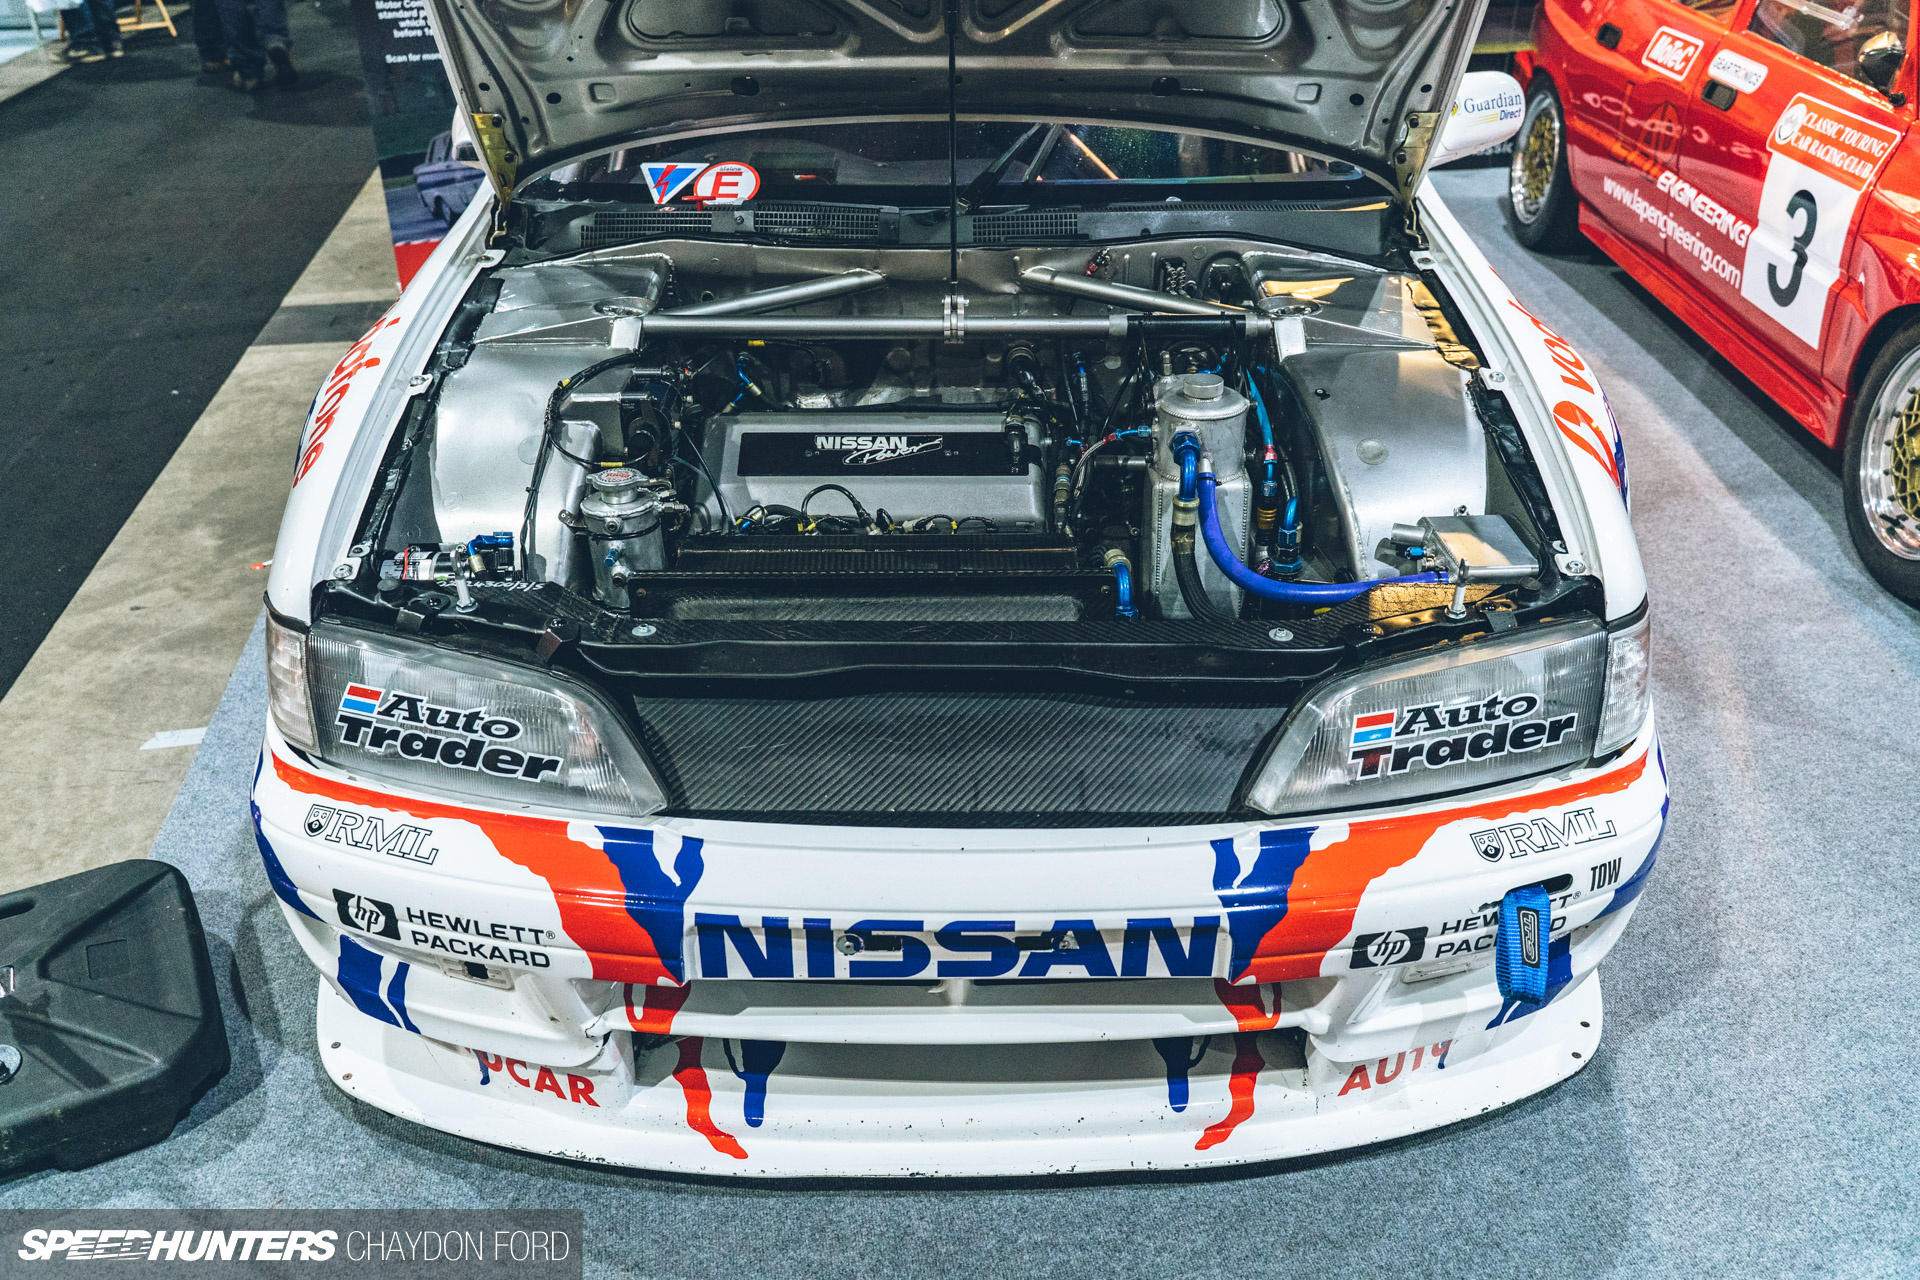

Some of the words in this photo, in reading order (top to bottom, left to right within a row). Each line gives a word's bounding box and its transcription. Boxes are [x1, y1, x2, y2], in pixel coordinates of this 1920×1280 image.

[378, 9, 418, 19] standard
[385, 54, 407, 63] Scan
[408, 53, 420, 61] for
[1464, 92, 1522, 113] Guardian
[1500, 108, 1522, 121] Direct
[1790, 131, 1813, 152] CAR
[1808, 139, 1848, 167] RACING
[1843, 155, 1874, 178] CLUB
[1803, 111, 1844, 139] CLASSIC
[1839, 126, 1888, 157] TOURING
[711, 171, 743, 198] E
[1656, 170, 1752, 248] ENGINEERING
[1603, 176, 1742, 289] www.lapengineering.com
[1767, 189, 1818, 308] 3
[816, 436, 907, 449] NISSAN
[377, 692, 521, 740] Auto
[1395, 692, 1539, 738] Auto
[337, 714, 562, 781] Trader
[1350, 713, 1577, 779] Trader
[325, 809, 439, 865] RML
[1500, 807, 1617, 859] RML
[1590, 857, 1622, 892] TOW
[411, 930, 551, 968] PACKARD
[695, 912, 1221, 979] NISSAN
